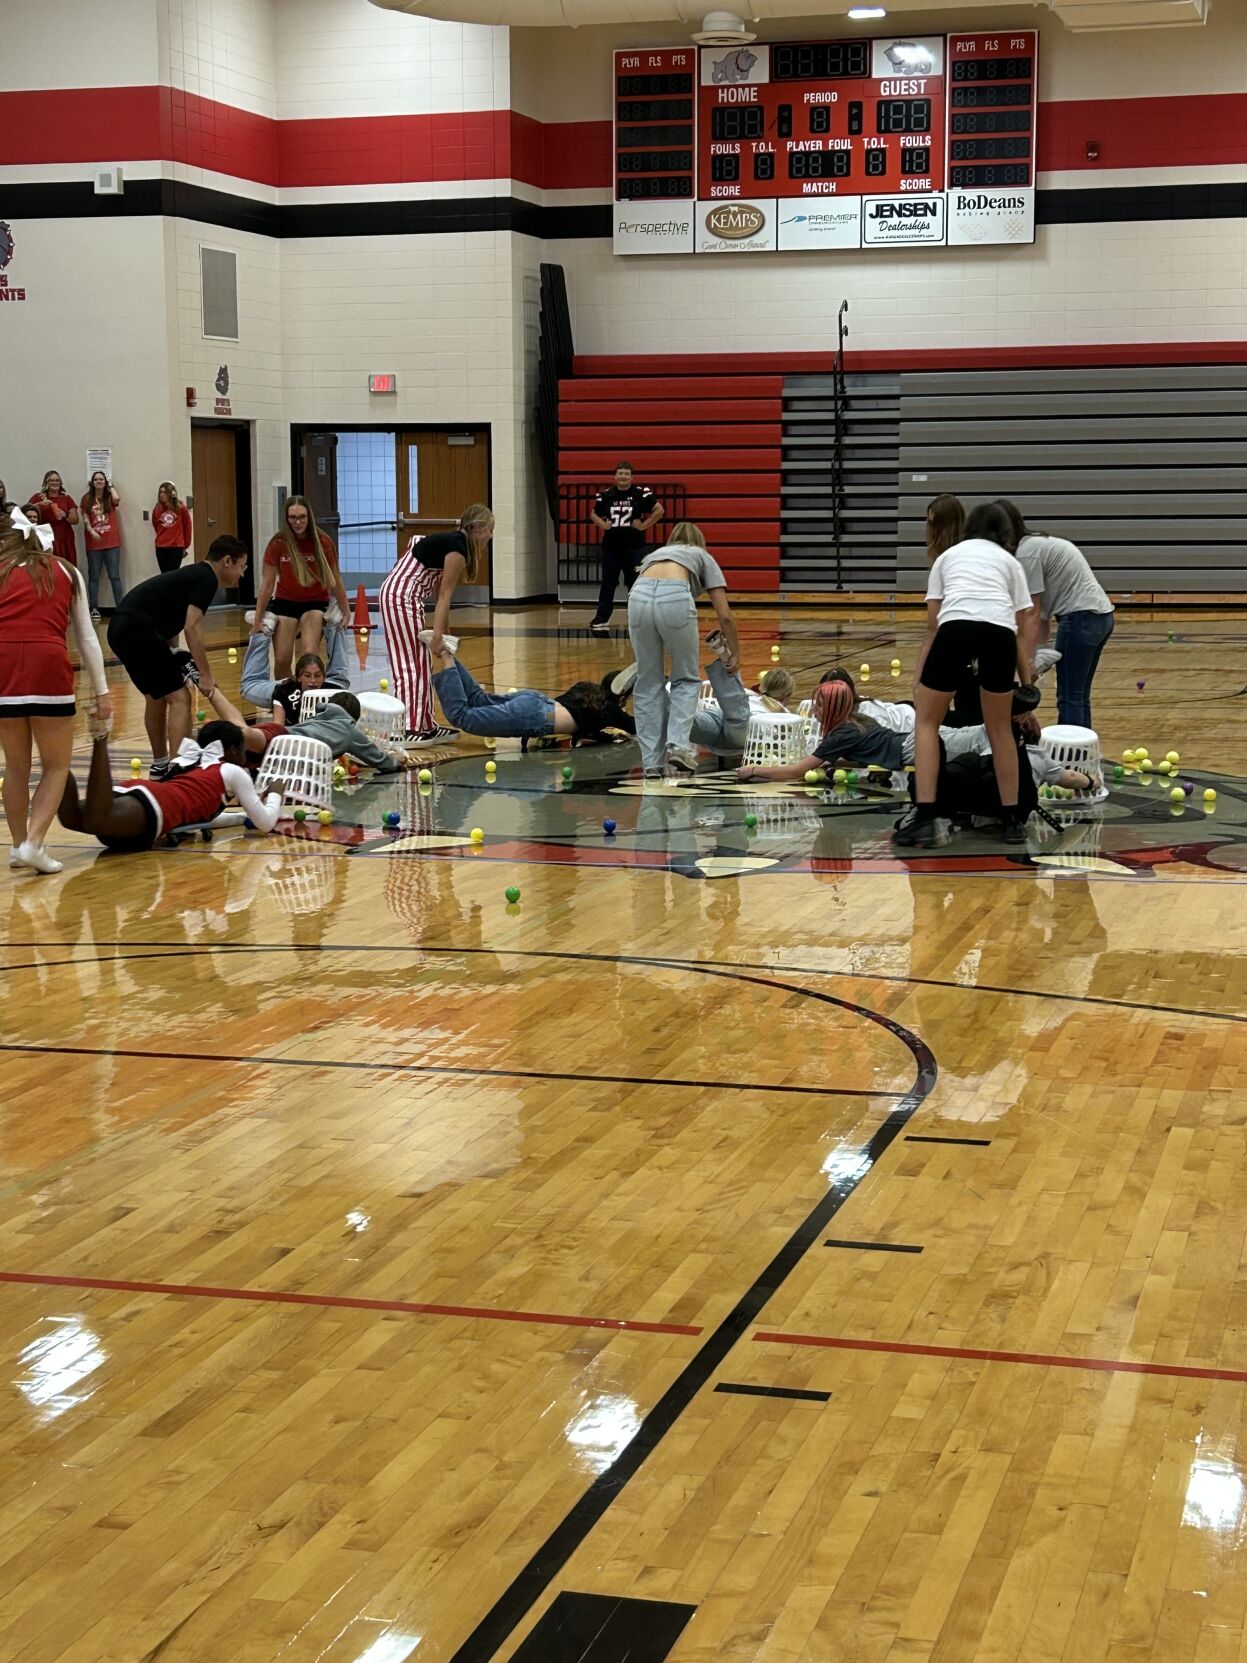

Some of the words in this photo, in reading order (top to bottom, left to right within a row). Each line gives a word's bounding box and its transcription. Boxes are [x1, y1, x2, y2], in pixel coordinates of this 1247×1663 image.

[956, 41, 976, 52] PLYR
[984, 40, 999, 50] FLS
[1010, 39, 1025, 49] PTS
[621, 57, 640, 68] PLYR
[648, 56, 662, 67] FLS
[672, 55, 686, 66] PTS
[880, 79, 927, 96] GUEST
[718, 87, 758, 103] HOME
[803, 92, 838, 103] PERIOD
[710, 143, 741, 154] FOULS
[751, 142, 777, 153] T.O.L.
[786, 140, 823, 152] PLAYER
[828, 139, 853, 150] FOUL
[863, 137, 889, 148] T.O.L.
[900, 136, 932, 147] FOULS
[710, 185, 741, 197] SCORE
[802, 182, 836, 193] MATCH
[900, 178, 932, 191] SCORE
[956, 195, 1025, 211] BoDeans
[868, 202, 937, 219] JENSEN
[618, 220, 690, 235] Perspective
[878, 219, 931, 233] Dealerships
[610, 506, 633, 527] 52
